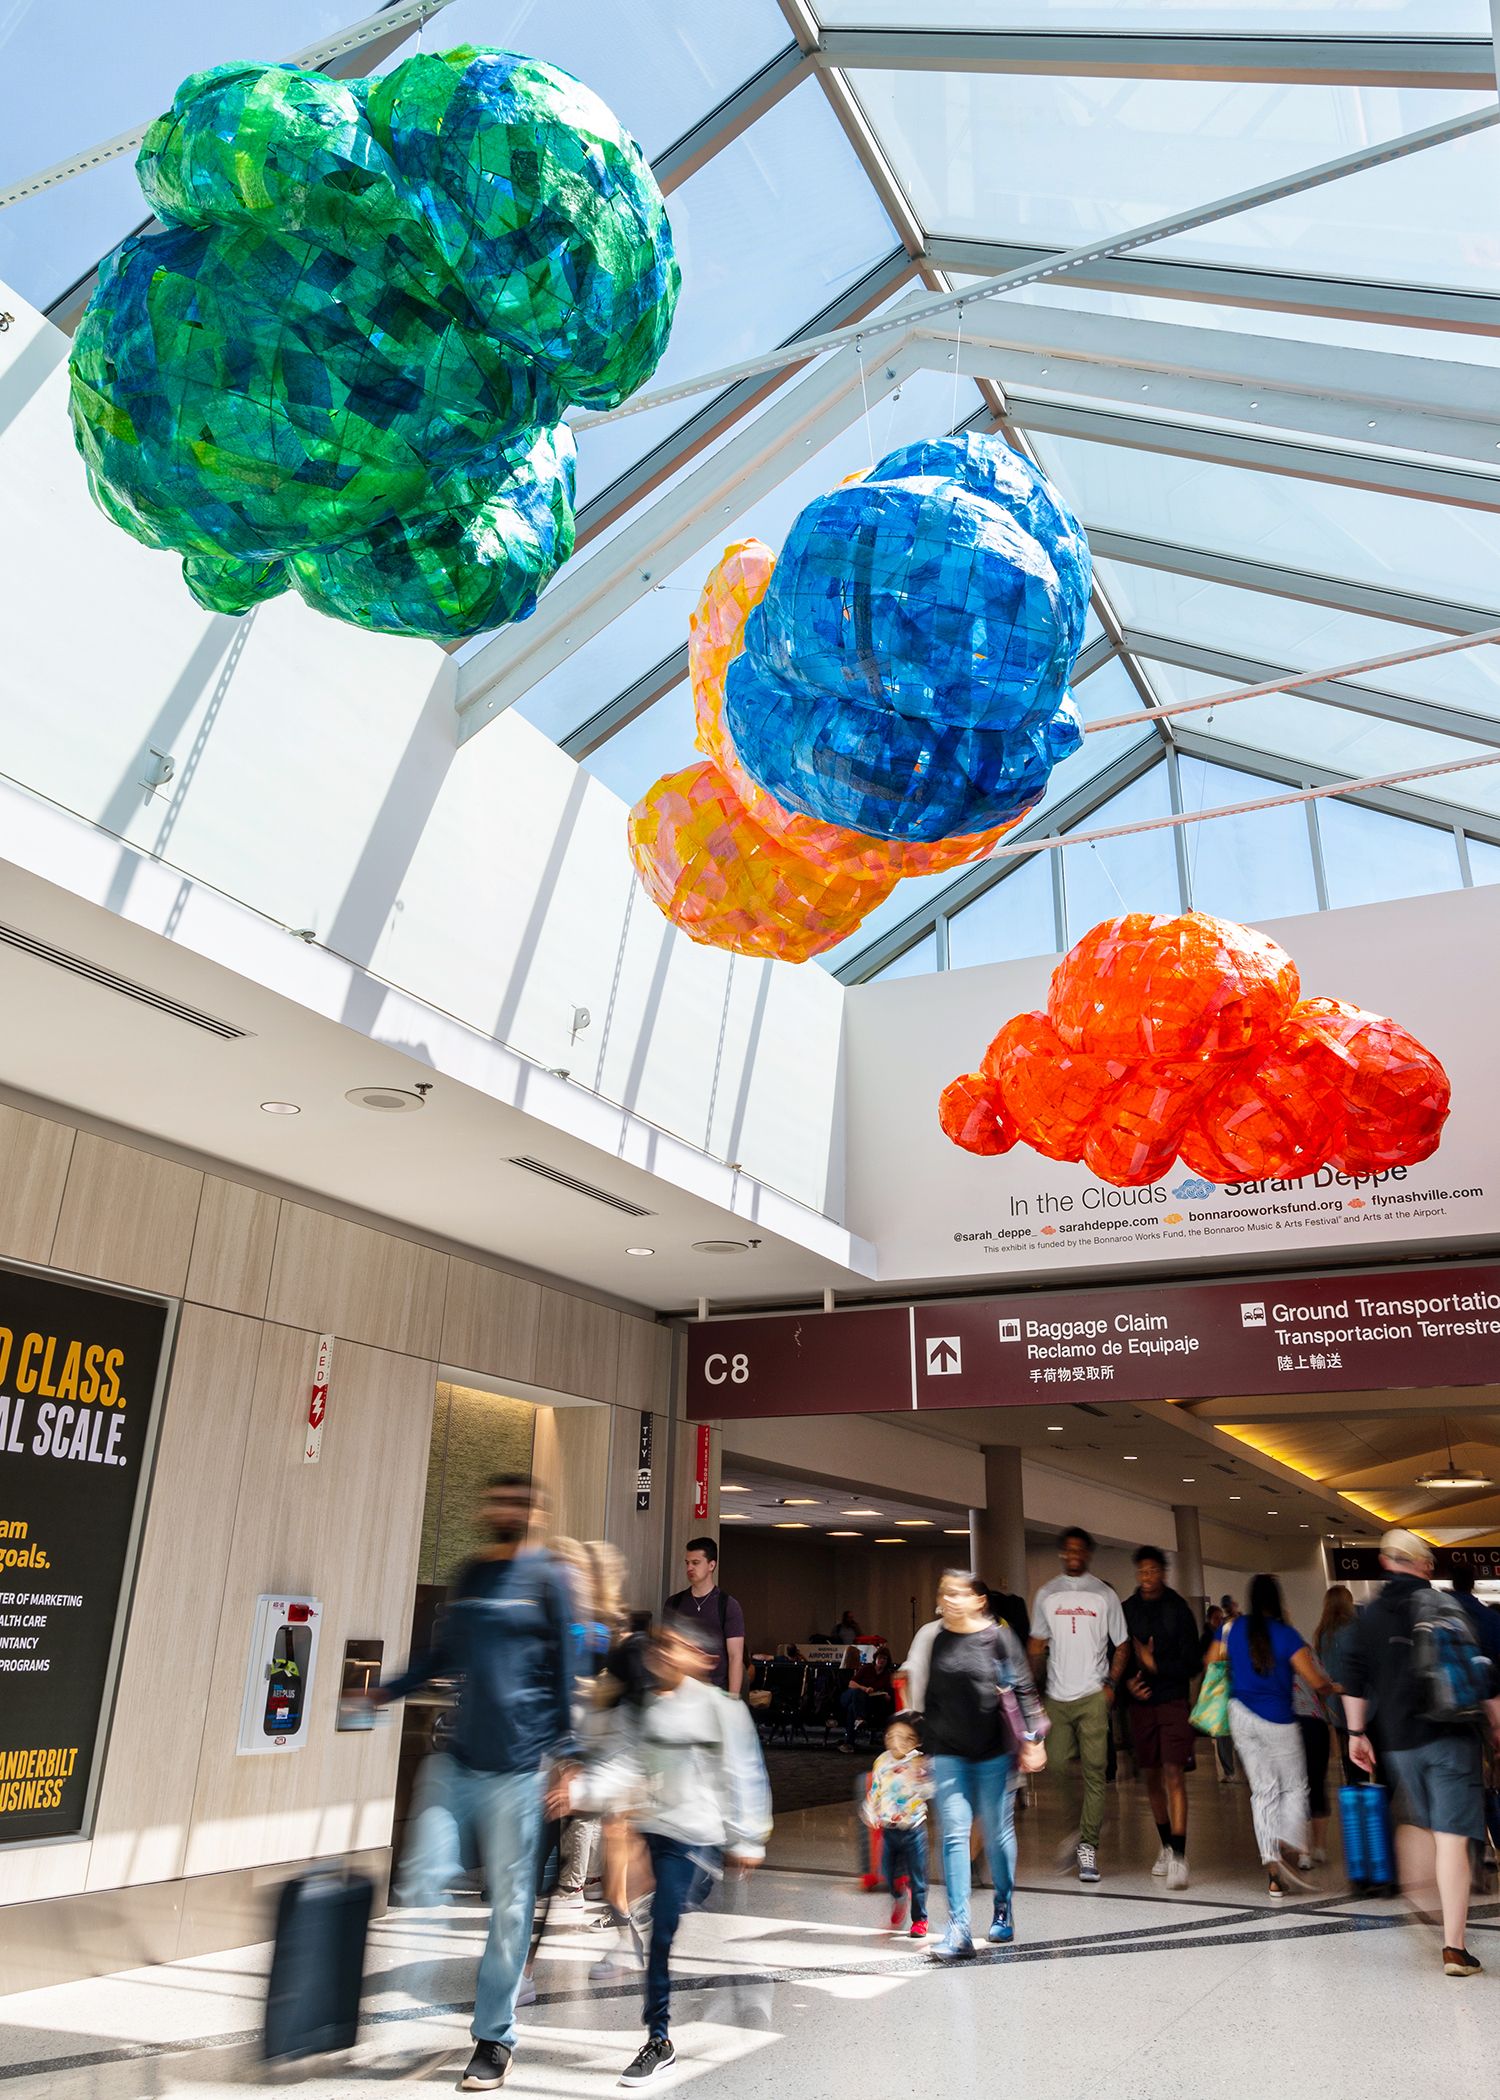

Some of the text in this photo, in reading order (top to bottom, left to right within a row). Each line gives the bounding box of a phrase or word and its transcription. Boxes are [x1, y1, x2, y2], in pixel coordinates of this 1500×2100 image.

[1010, 1183, 1167, 1216] In the Clouds
[1371, 1187, 1484, 1207] flynashville.com
[1188, 1200, 1343, 1222] bonnarooworksfund.org
[953, 1228, 1038, 1242] @sarah_deppe_
[984, 1245, 1000, 1253] This
[1001, 1243, 1027, 1252] exhibit
[1029, 1242, 1035, 1250] is
[1037, 1240, 1065, 1249] funded
[1067, 1239, 1077, 1248] by
[1079, 1238, 1092, 1246] the
[1094, 1234, 1133, 1244] Bonnaroo
[1135, 1232, 1161, 1241] Works
[1163, 1229, 1187, 1239] Fund,
[1188, 1228, 1202, 1237] the
[1204, 1224, 1245, 1235] Bonnaroo
[1247, 1221, 1273, 1231] Music
[1275, 1221, 1282, 1229] &
[1284, 1219, 1302, 1228] Arts
[1343, 1214, 1360, 1223] and
[1363, 1213, 1381, 1222] Arts
[1384, 1211, 1393, 1220] at
[1396, 1210, 1410, 1219] the
[1413, 1207, 1447, 1219] Airport.
[1059, 1216, 1159, 1233] sarahdeppe.com
[1272, 1300, 1349, 1322] Ground
[1026, 1313, 1168, 1341] Baggage Claim
[1275, 1318, 1500, 1346] Transportacion Terrestre
[1027, 1335, 1200, 1360] Reclamo de Equipaje
[16, 1332, 127, 1409] CLASS.
[317, 1341, 328, 1381] AED
[704, 1353, 749, 1385] C8
[1277, 1352, 1342, 1371] 陸上輸送
[1029, 1365, 1114, 1383] 手荷物受取所
[32, 1402, 127, 1467] SCALE.
[1341, 1558, 1359, 1570] C6
[1451, 1551, 1468, 1563] C1
[1473, 1551, 1486, 1563] to
[16, 1592, 30, 1605] OF
[30, 1593, 83, 1607] MARKETING
[22, 1615, 48, 1628] CARE
[0, 1636, 39, 1649] NTANCY
